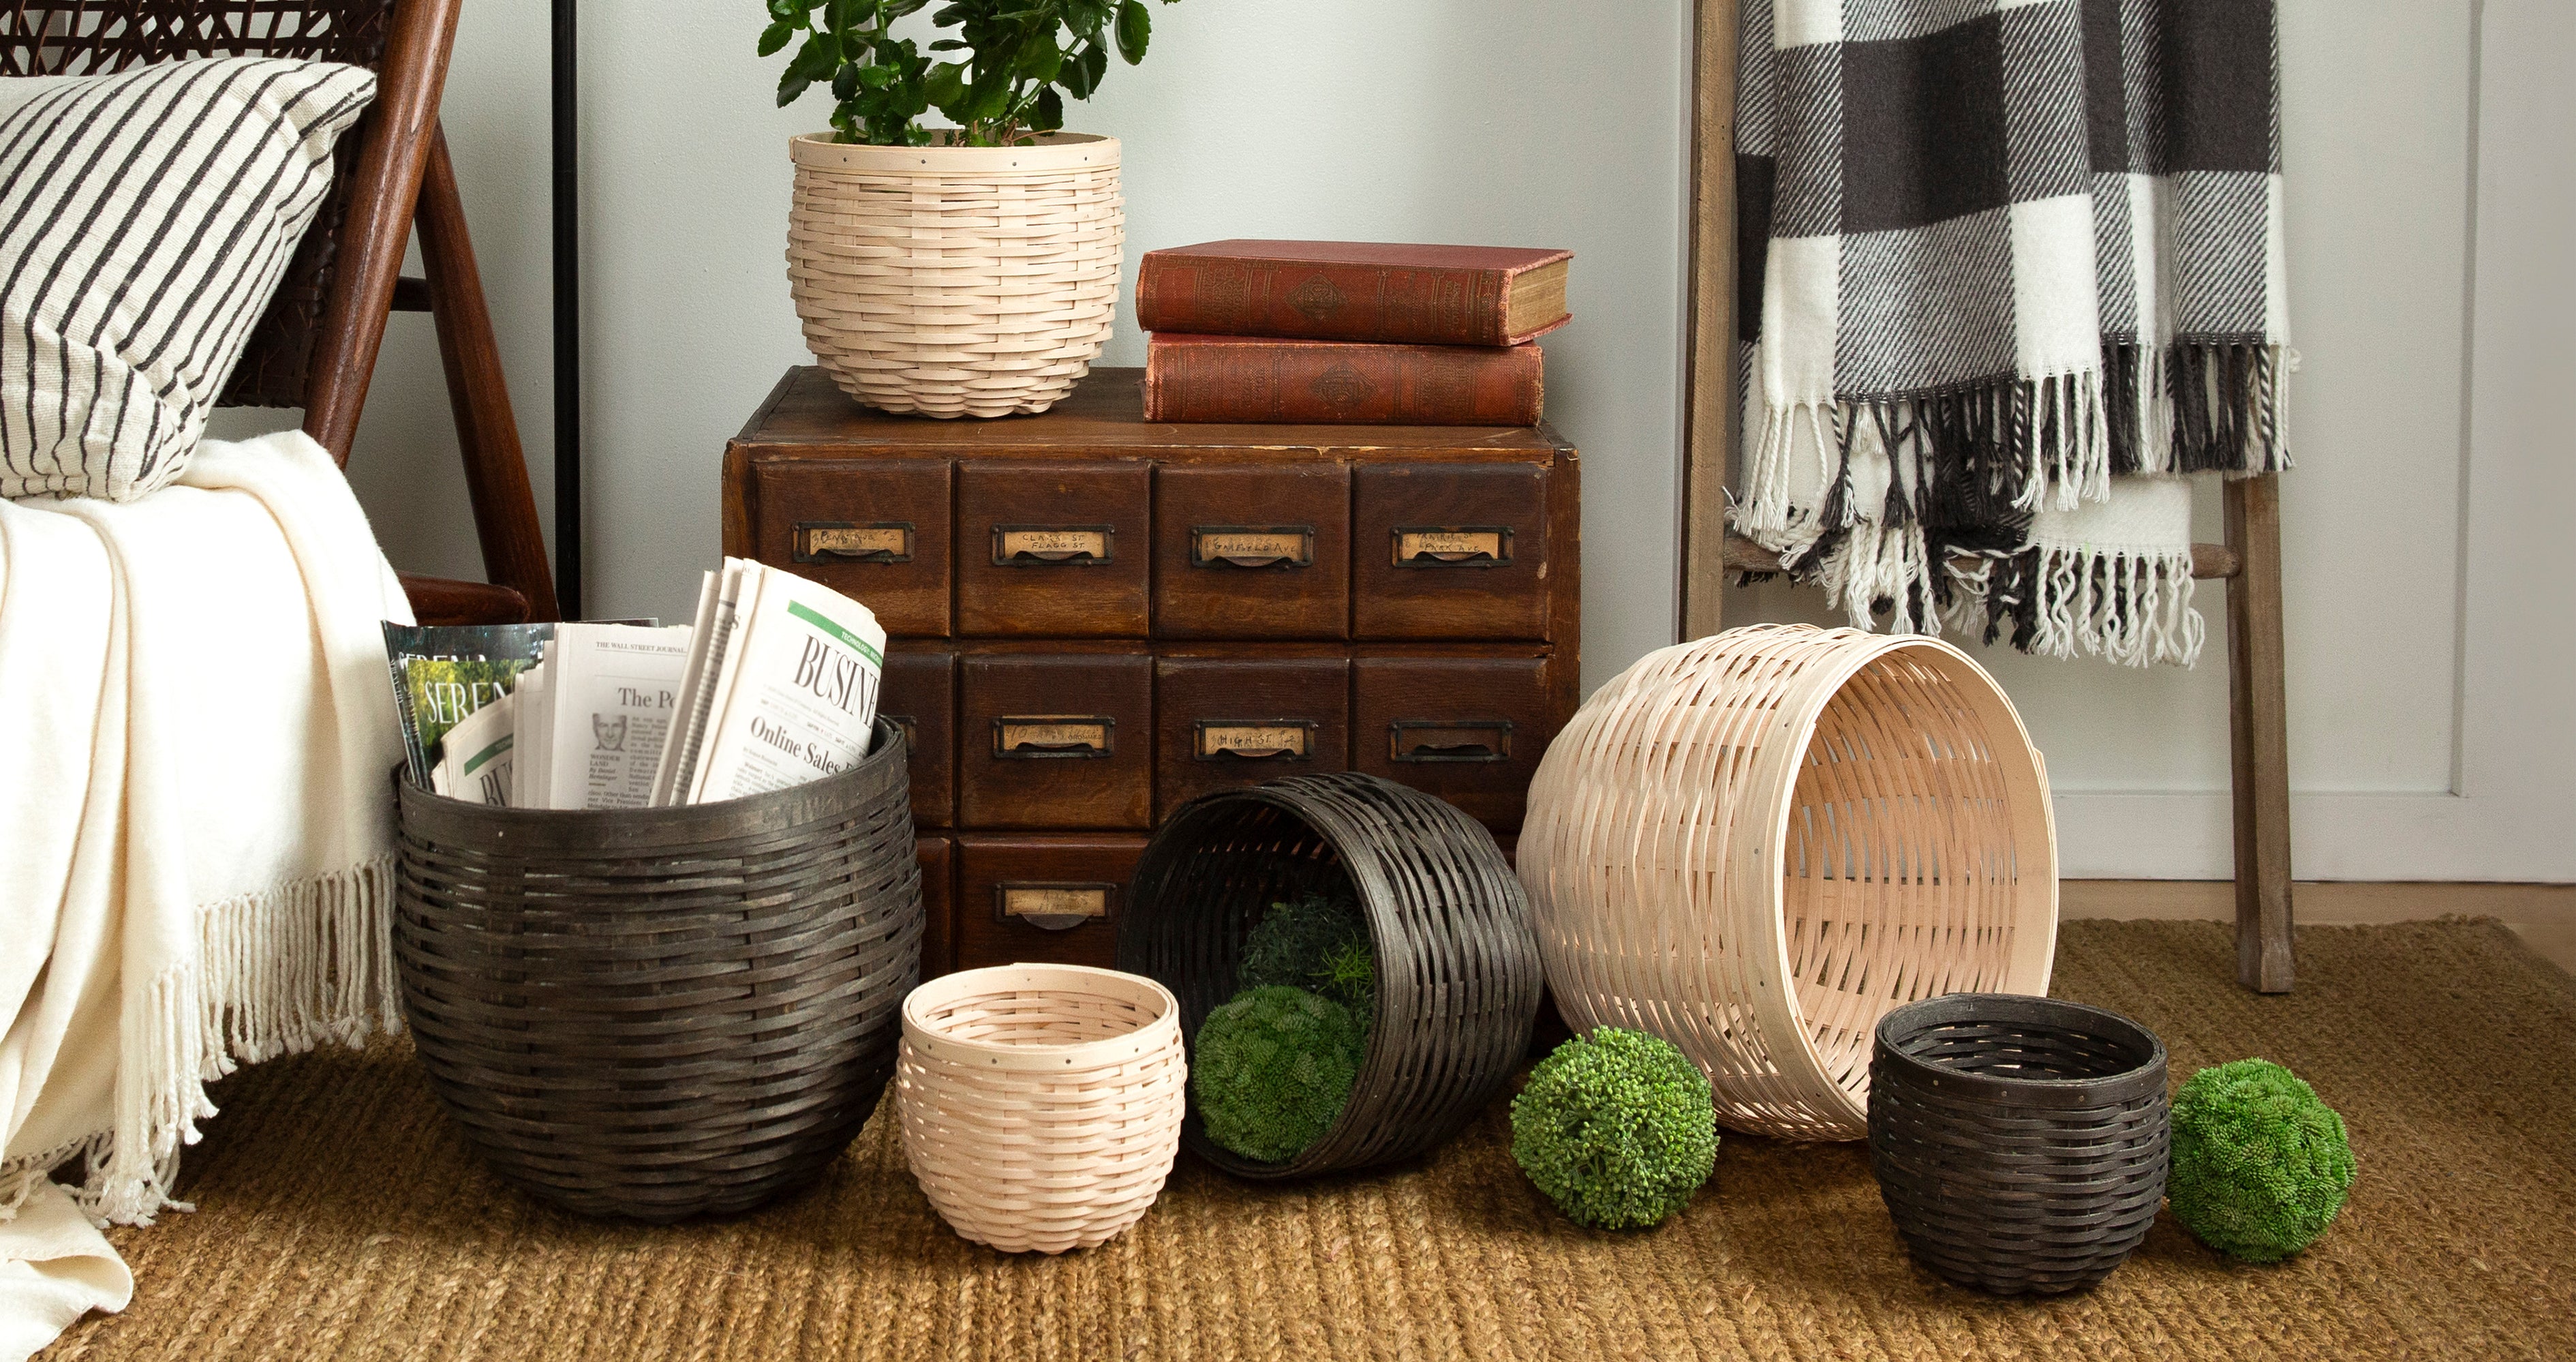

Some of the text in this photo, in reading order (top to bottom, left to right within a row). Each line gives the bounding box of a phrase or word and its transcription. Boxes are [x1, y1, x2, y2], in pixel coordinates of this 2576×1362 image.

[611, 641, 629, 650] WALL
[630, 644, 656, 652] STREET
[617, 686, 652, 708] The
[750, 716, 802, 758] Online
[803, 742, 842, 776] Sales
[1219, 734, 1253, 746] HIGH
[590, 753, 621, 762] WONDER
